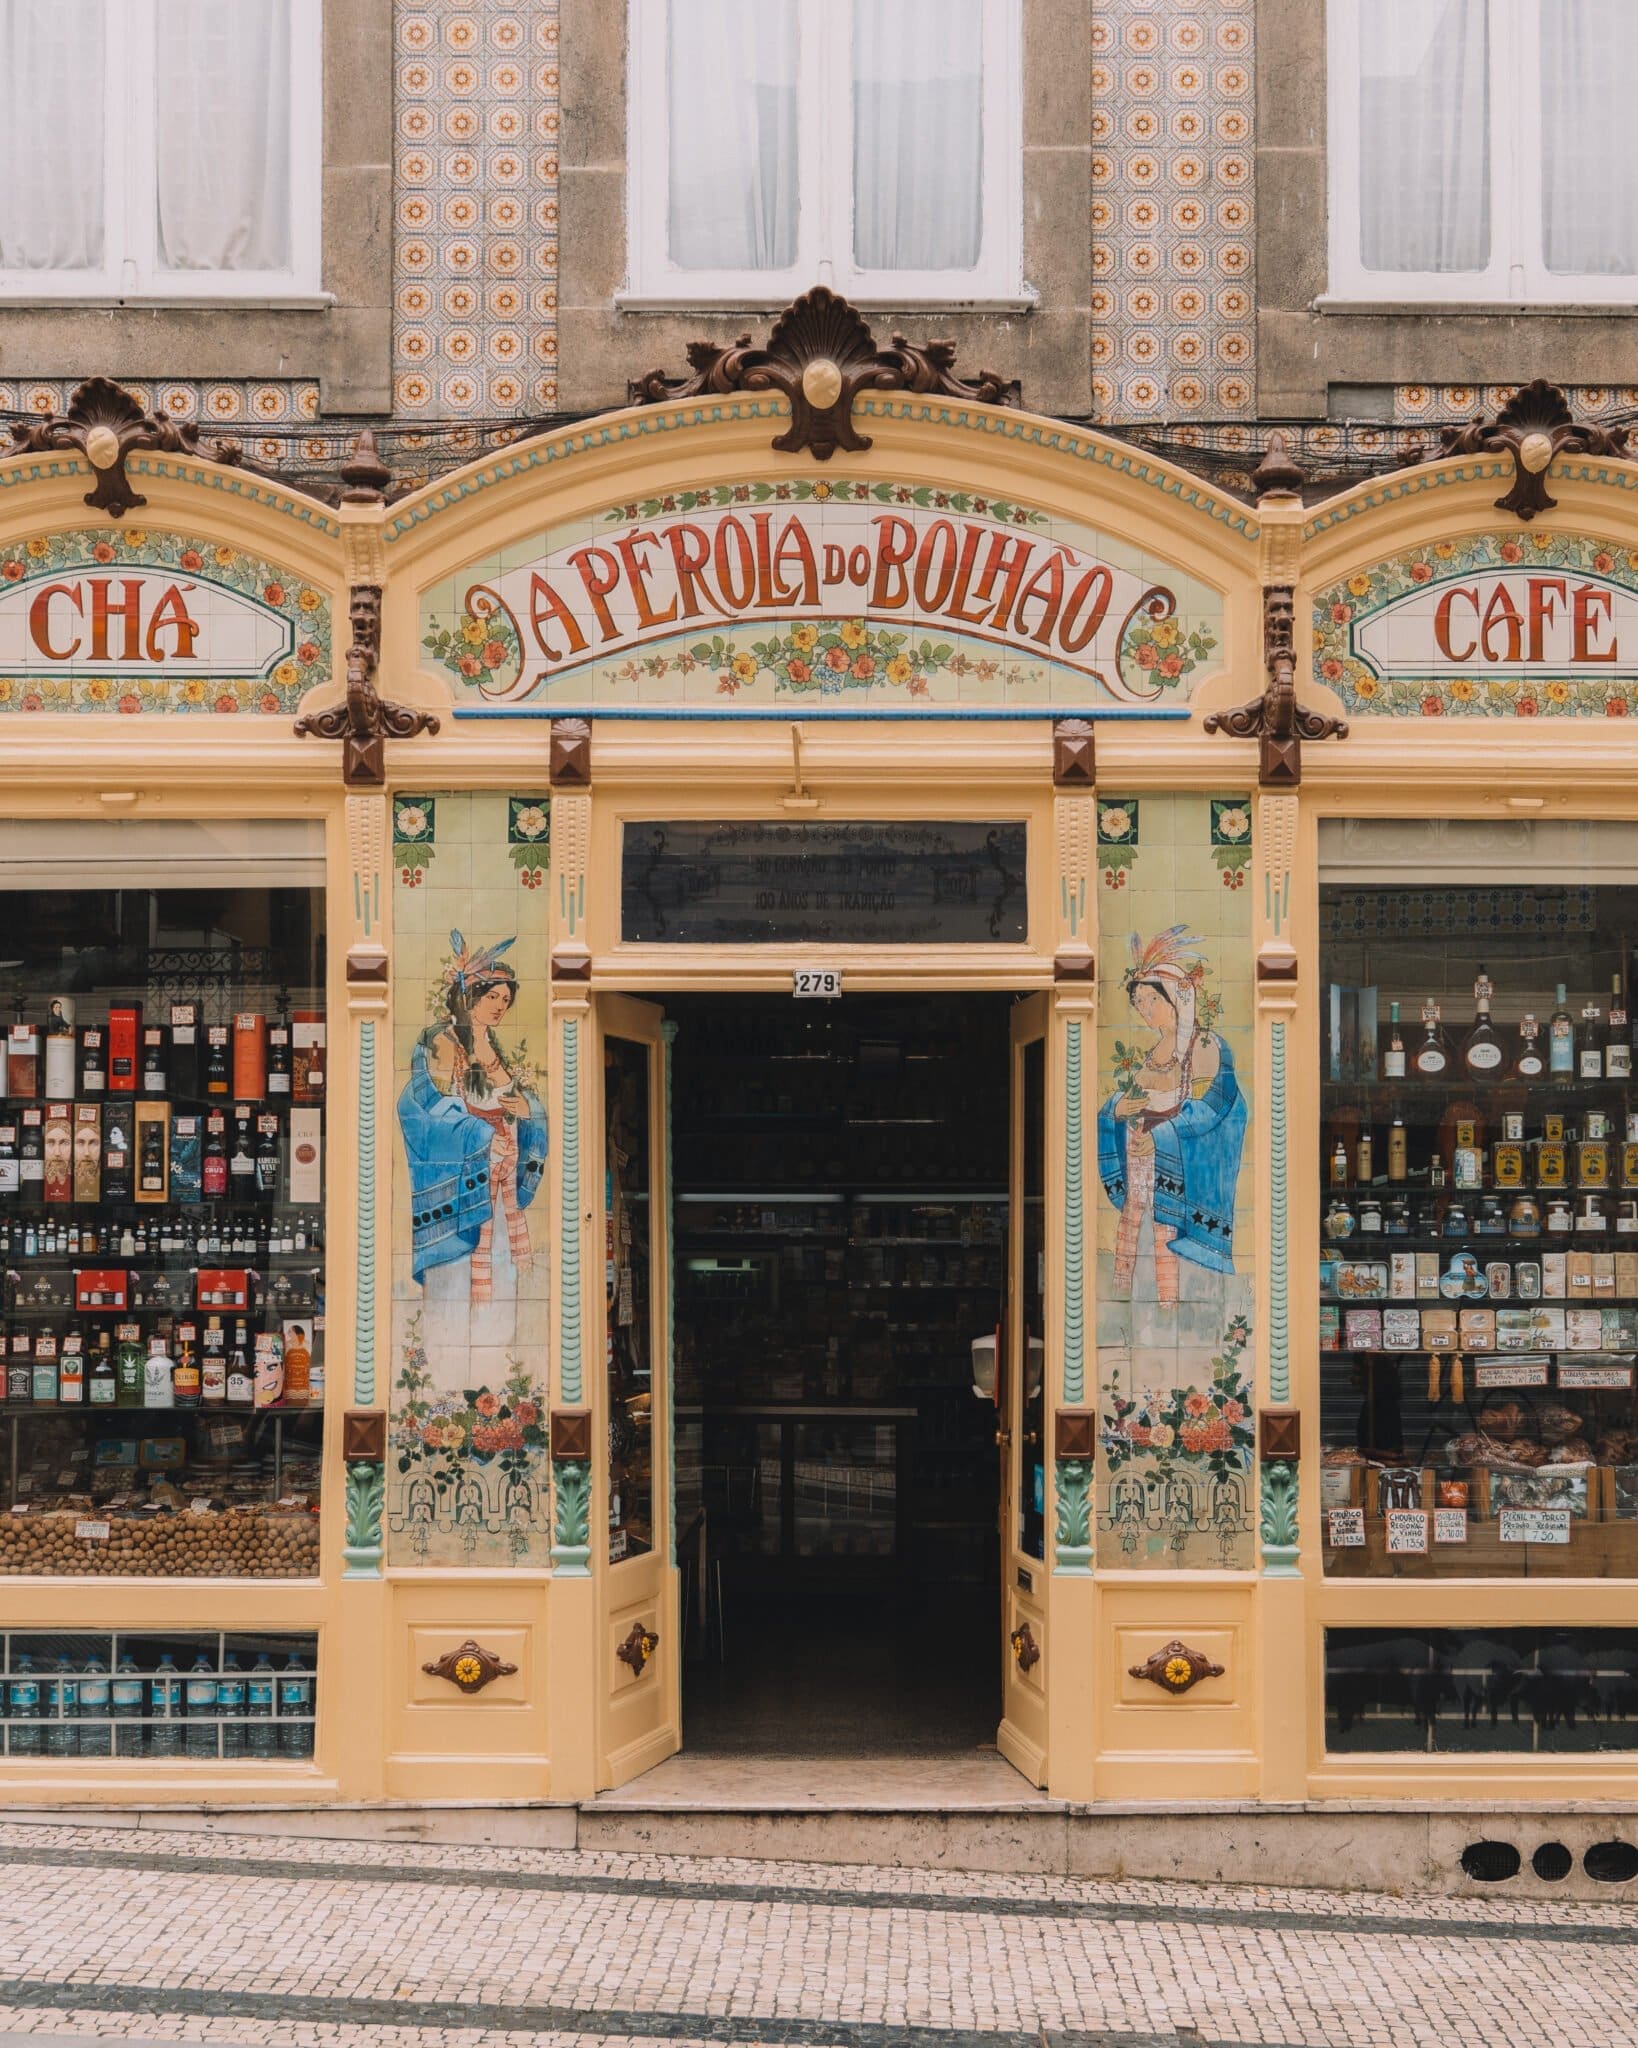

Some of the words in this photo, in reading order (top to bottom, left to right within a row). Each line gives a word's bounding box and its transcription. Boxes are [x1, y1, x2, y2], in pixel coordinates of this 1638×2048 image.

[530, 571, 591, 662] A
[566, 512, 822, 643] PÉROLA
[867, 514, 1114, 653] BOLHÃO
[29, 579, 200, 662] CHÁ
[1434, 578, 1618, 662] CAFÉ
[779, 890, 809, 911] ANOS
[816, 892, 830, 910] DE
[839, 889, 896, 914] TRADIÇÃO
[800, 974, 834, 992] 279
[230, 1376, 244, 1386] 35
[1540, 1511, 1567, 1521] PORCO
